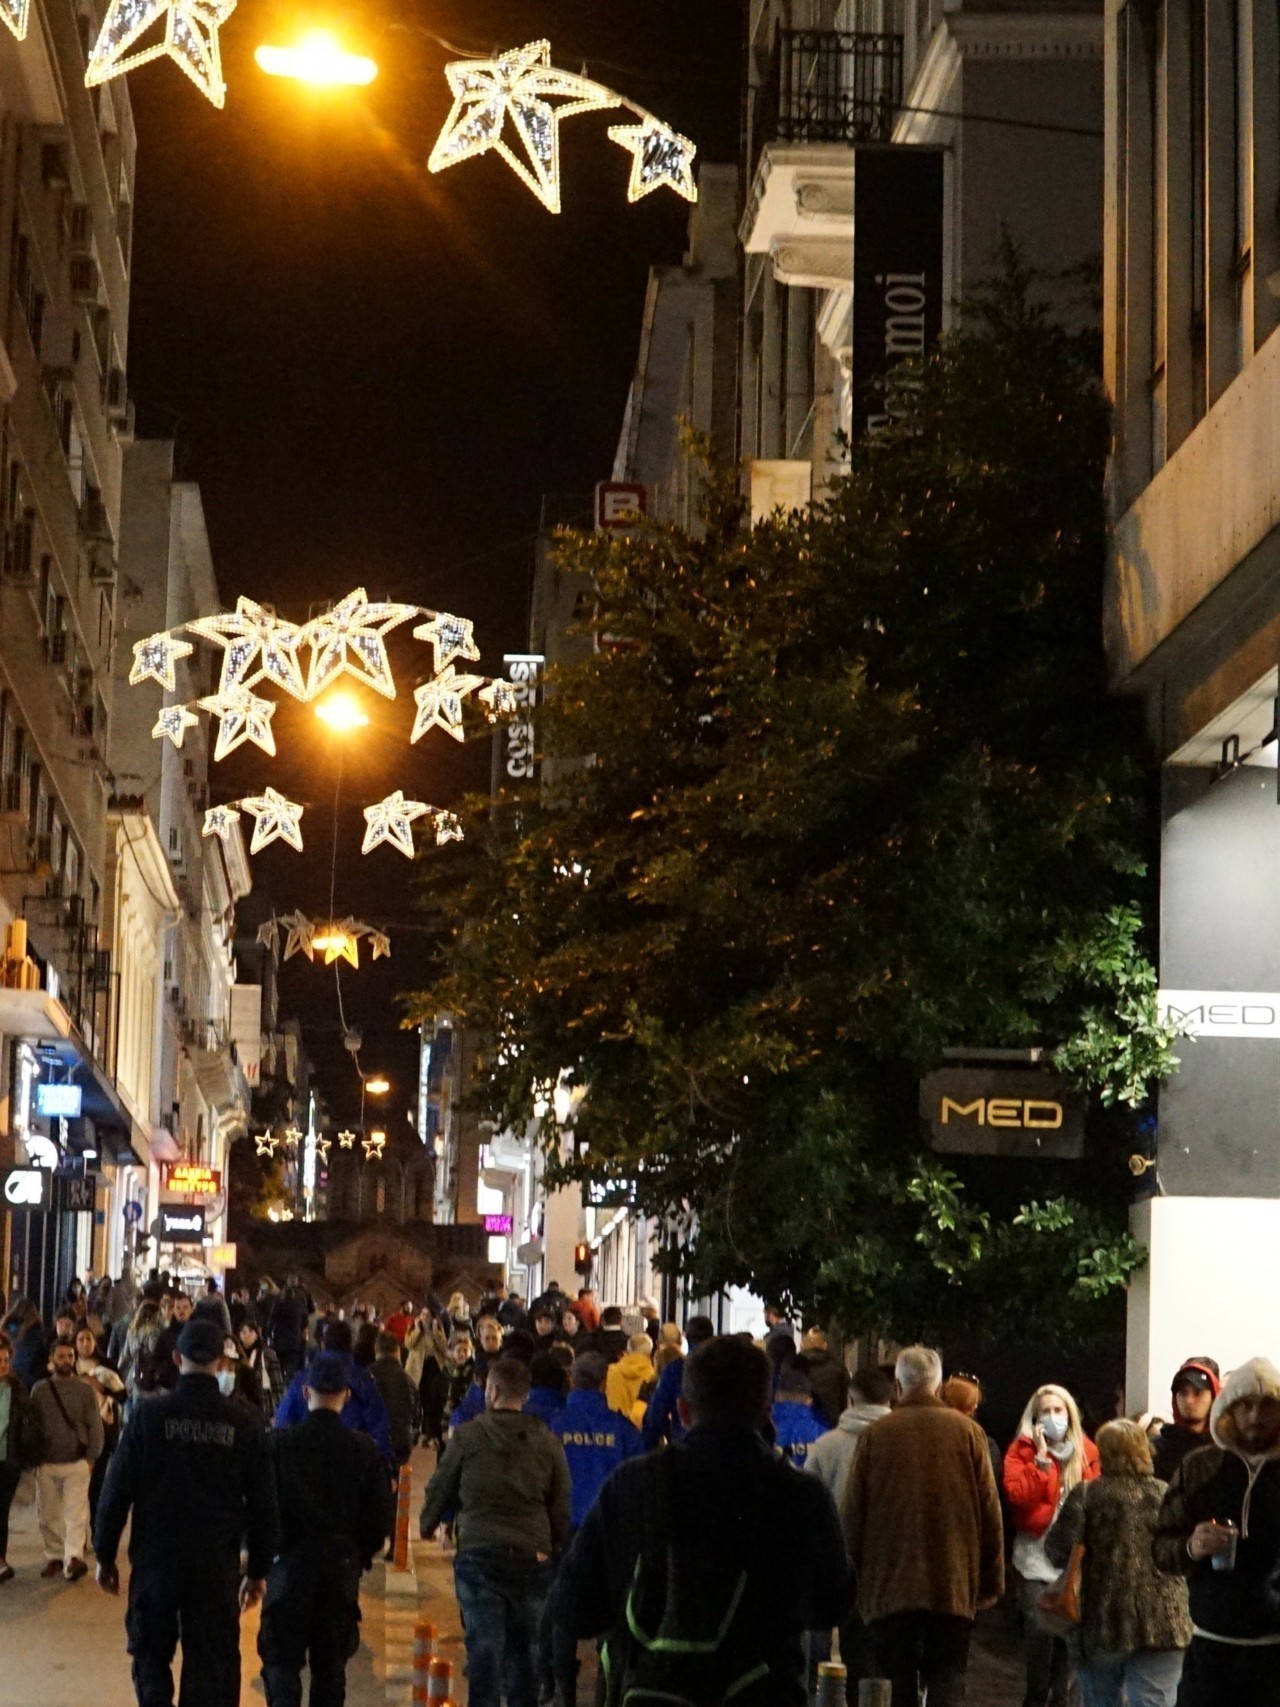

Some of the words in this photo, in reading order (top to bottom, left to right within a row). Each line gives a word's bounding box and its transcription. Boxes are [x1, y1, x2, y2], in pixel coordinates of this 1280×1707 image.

[1167, 1004, 1276, 1026] MED
[940, 1096, 1063, 1129] MED
[562, 1431, 616, 1447] POLICE
